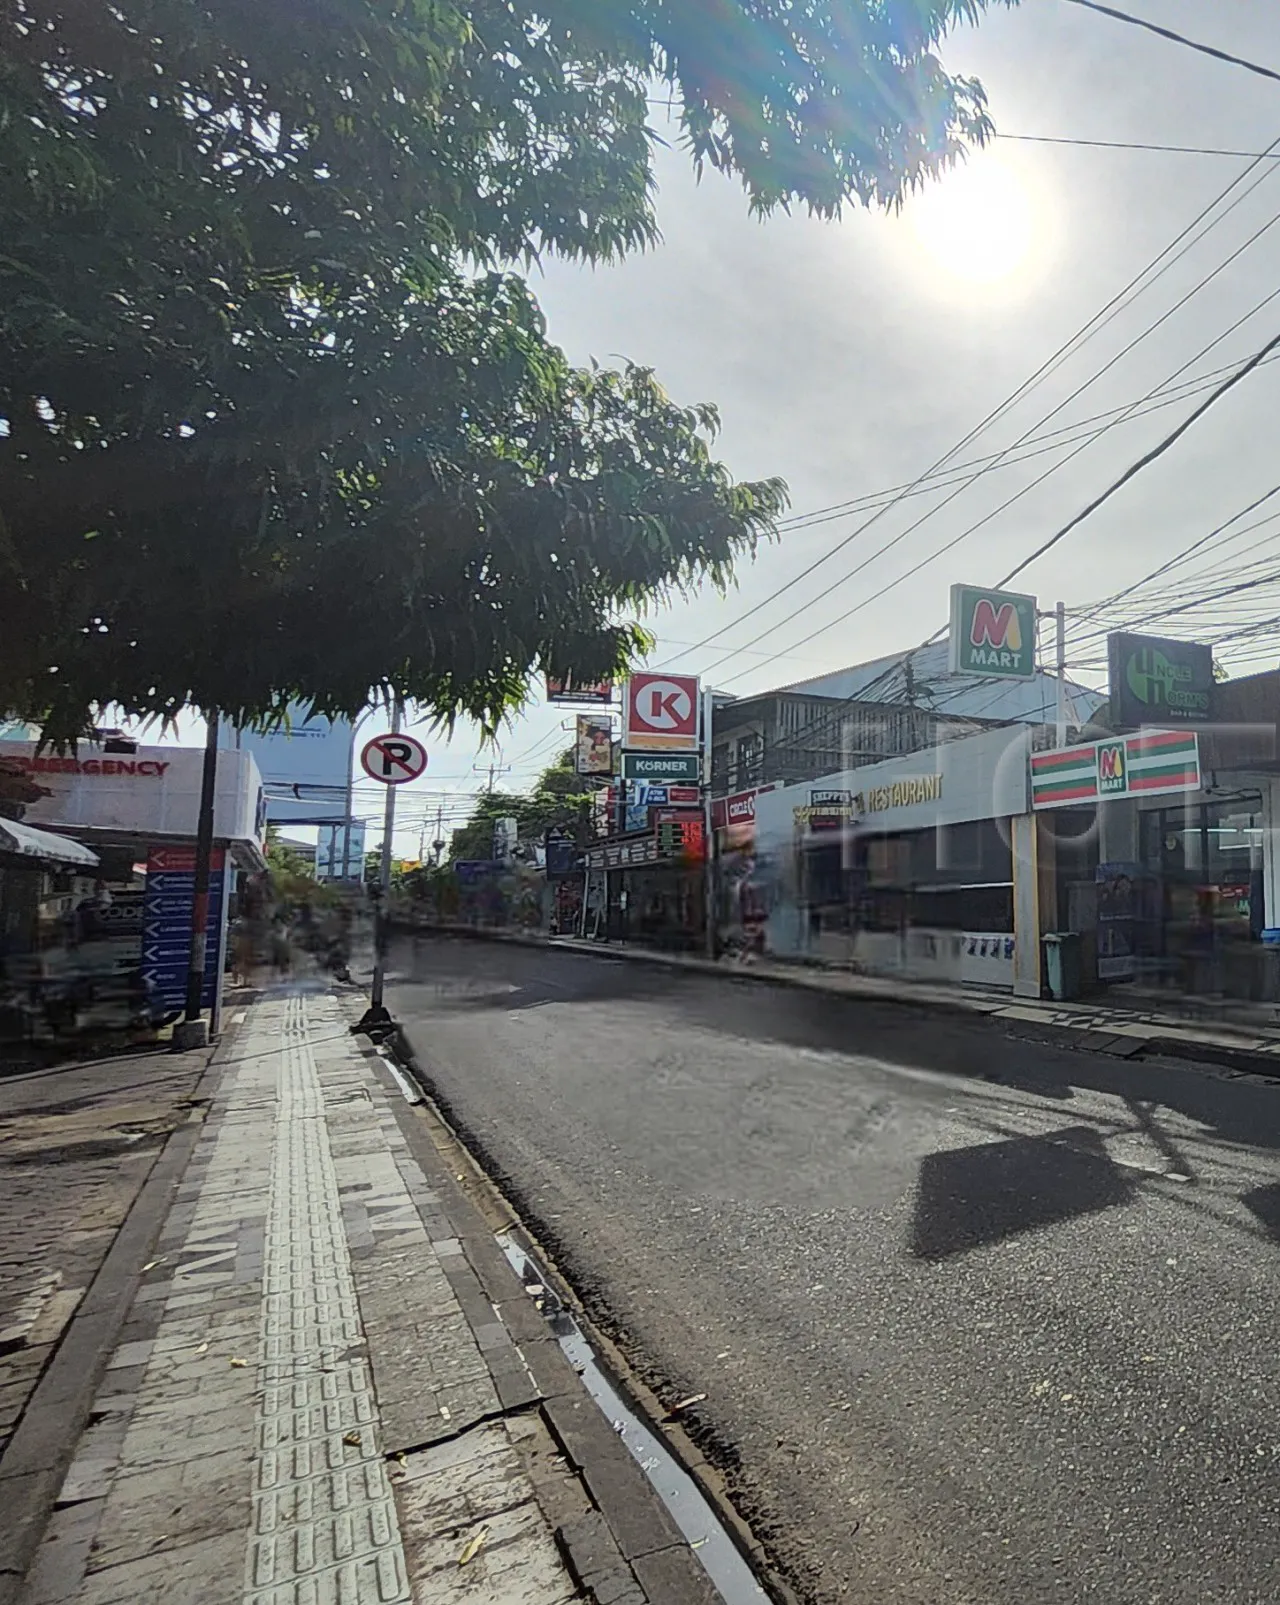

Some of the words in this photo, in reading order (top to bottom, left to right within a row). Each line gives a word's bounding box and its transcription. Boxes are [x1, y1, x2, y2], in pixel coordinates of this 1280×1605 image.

[970, 649, 1022, 668] MART
[869, 772, 943, 812] RESTAURANT
[1101, 778, 1123, 790] MART
